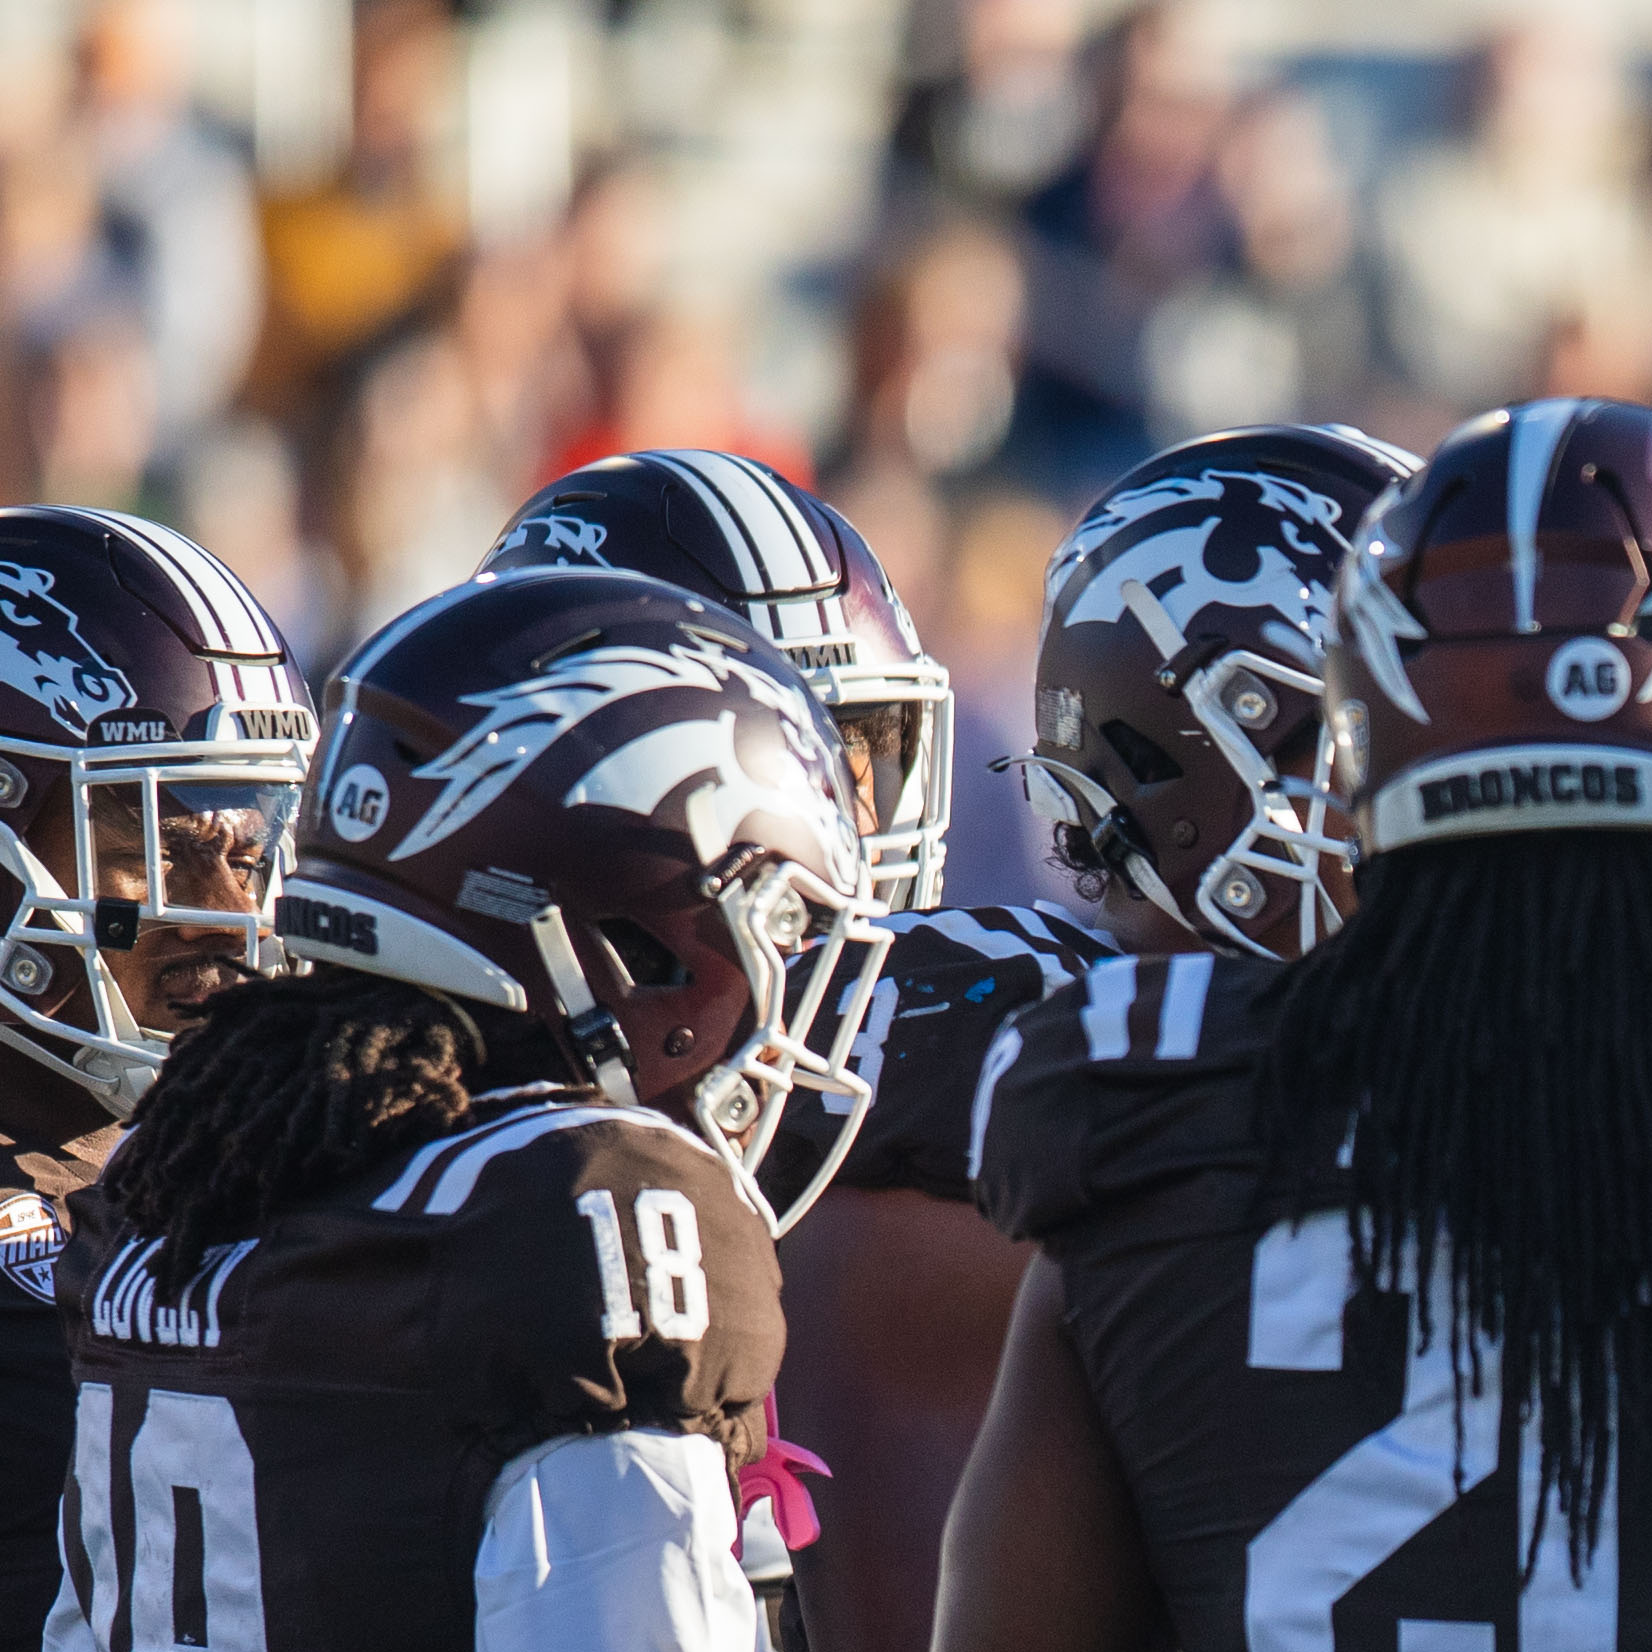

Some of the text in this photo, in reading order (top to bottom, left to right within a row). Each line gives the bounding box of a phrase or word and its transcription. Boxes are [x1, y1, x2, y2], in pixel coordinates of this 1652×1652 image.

[1564, 664, 1617, 695] AG
[100, 722, 166, 741] WMU
[239, 710, 312, 740] WMU
[337, 783, 384, 825] AG
[1420, 765, 1638, 821] BRONCOS
[576, 1188, 710, 1341] 18
